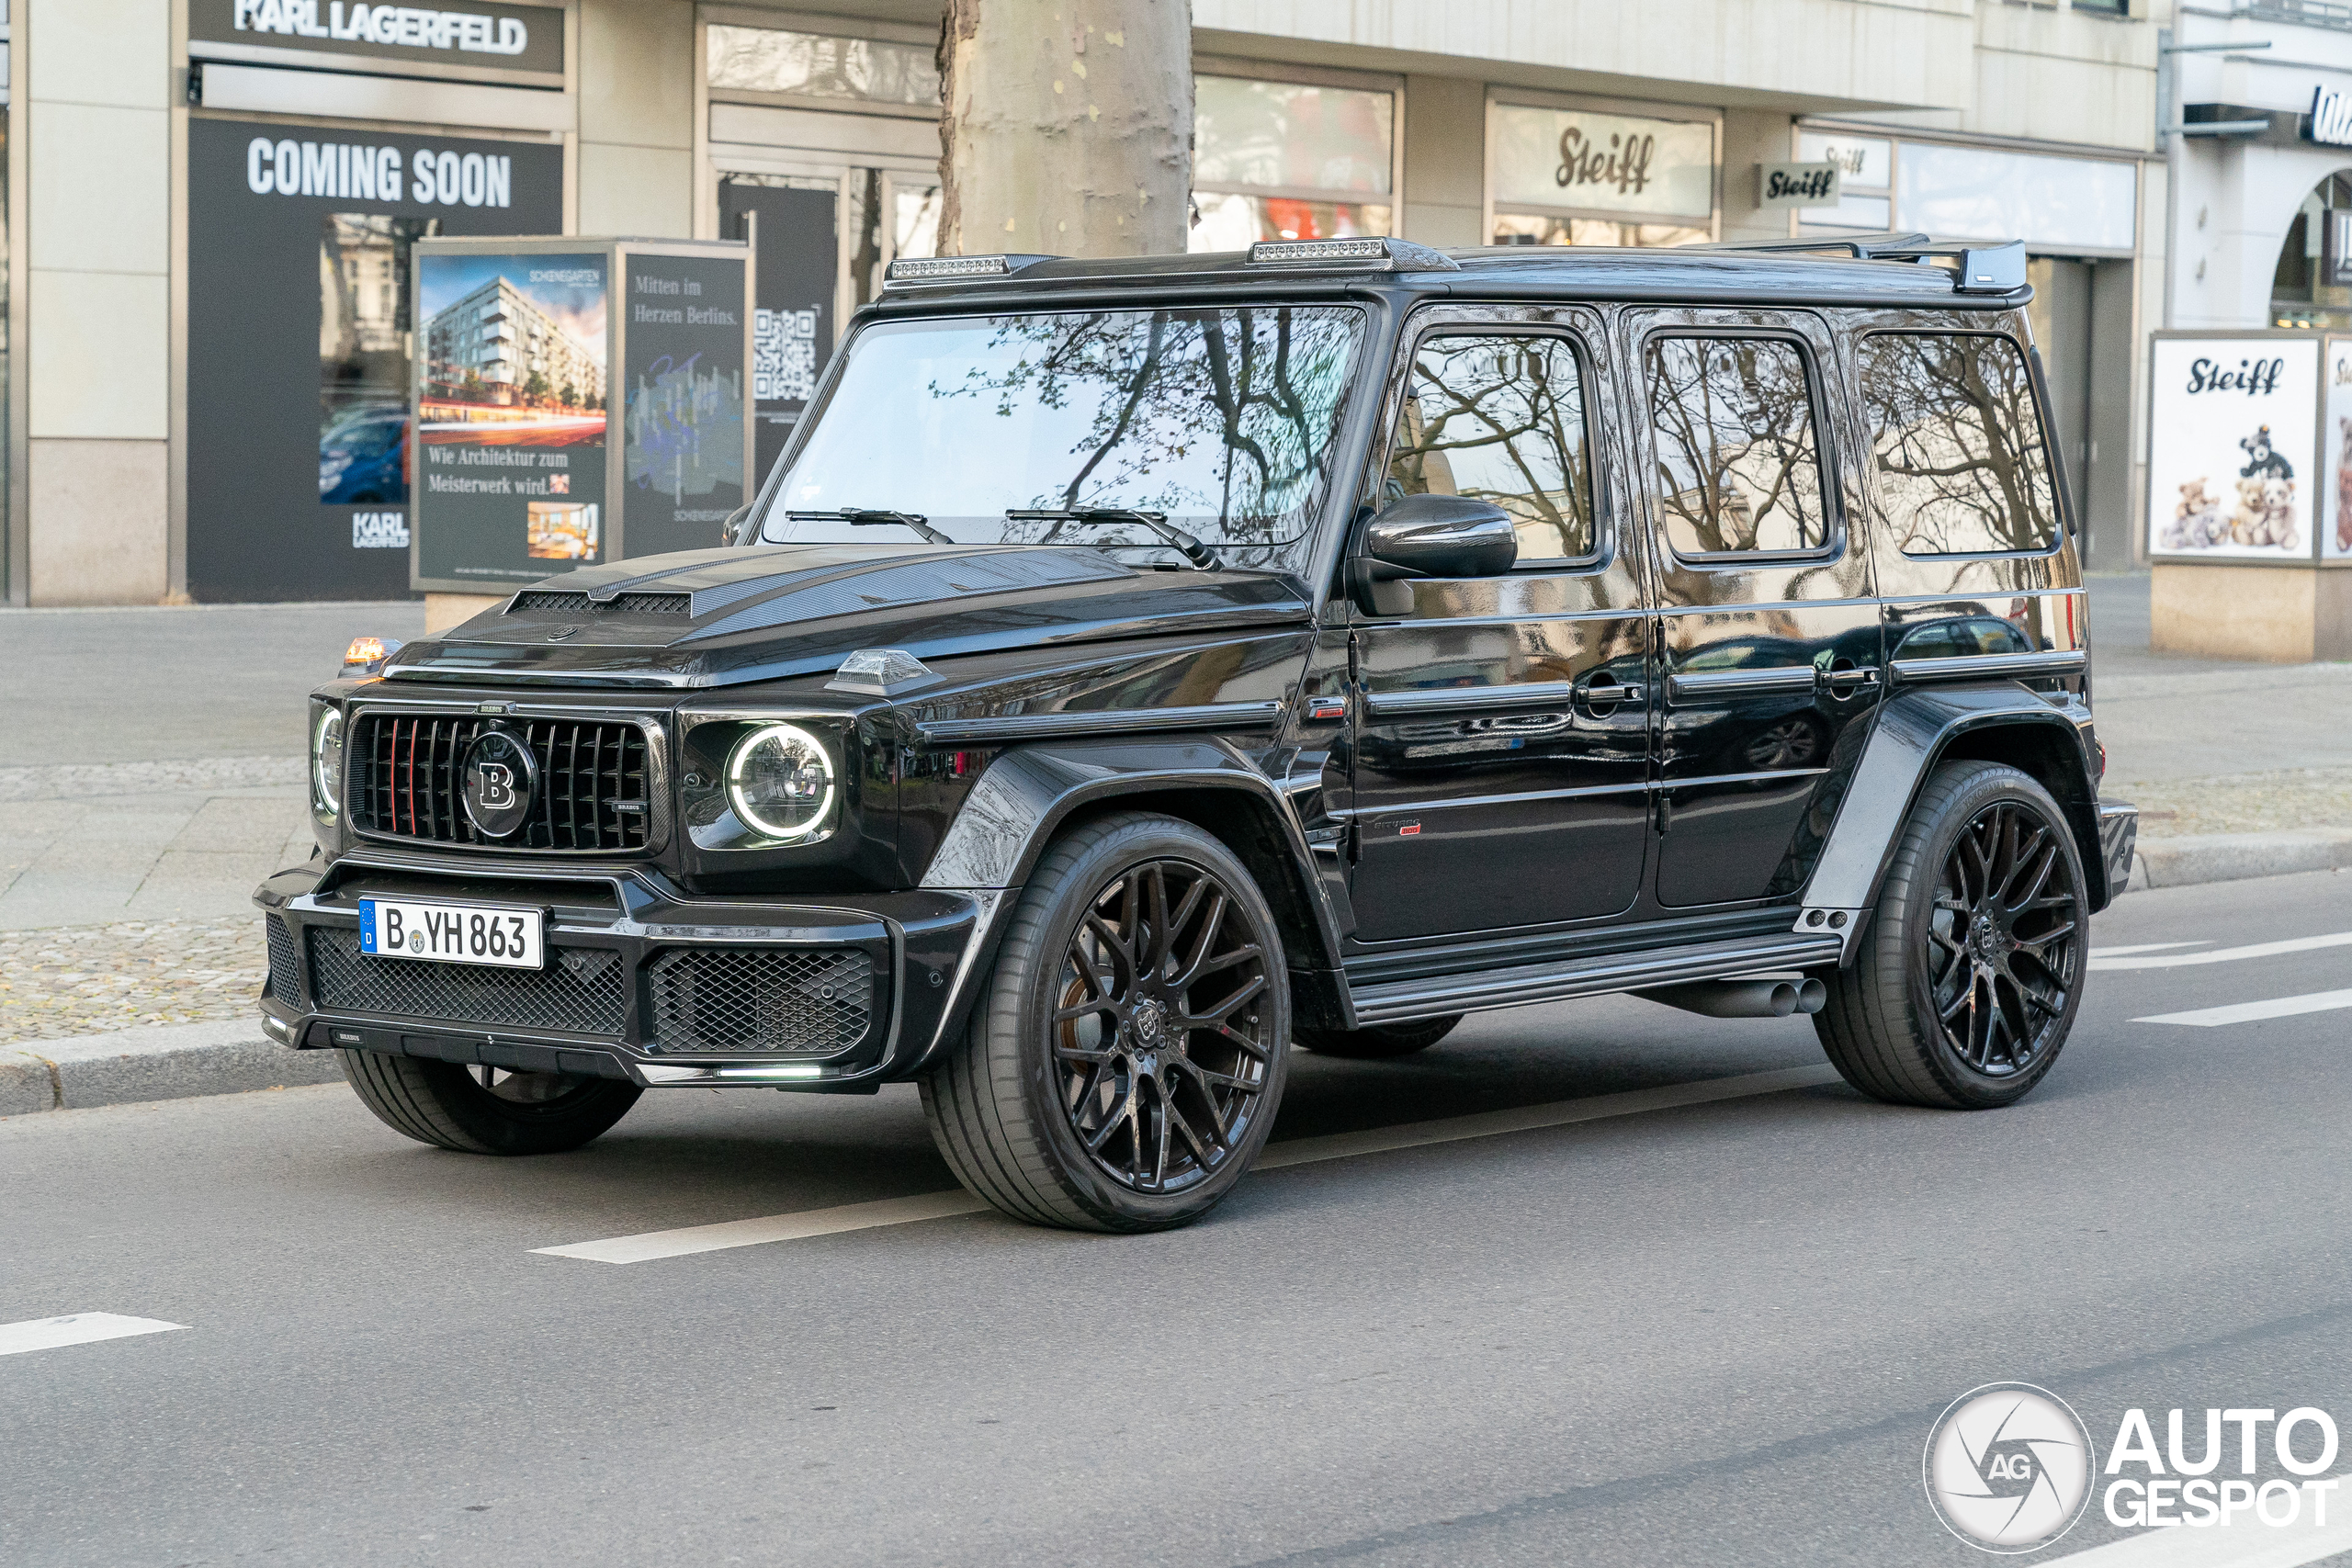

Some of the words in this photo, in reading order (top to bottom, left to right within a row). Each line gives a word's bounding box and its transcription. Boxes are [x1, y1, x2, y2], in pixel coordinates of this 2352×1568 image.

[234, 0, 329, 38] KARL
[329, 1, 528, 55] LAGERFELD
[247, 137, 402, 202] COMING
[412, 148, 511, 209] SOON
[1555, 126, 1655, 195] Steiff
[1767, 169, 1834, 199] Steiff
[635, 276, 680, 296] Mitten
[684, 277, 702, 296] im
[634, 304, 683, 323] Herzen
[687, 306, 738, 325] Berlins.
[2186, 356, 2285, 396] Steiff
[428, 446, 455, 465] Wie
[458, 447, 535, 468] Architektur
[538, 453, 569, 468] zum
[428, 473, 512, 494] Meisterwerk
[514, 477, 550, 495] wird.
[353, 512, 410, 537] KARL
[365, 931, 373, 944] D
[386, 908, 405, 949] B
[424, 910, 463, 954] YH
[470, 914, 526, 959] 863
